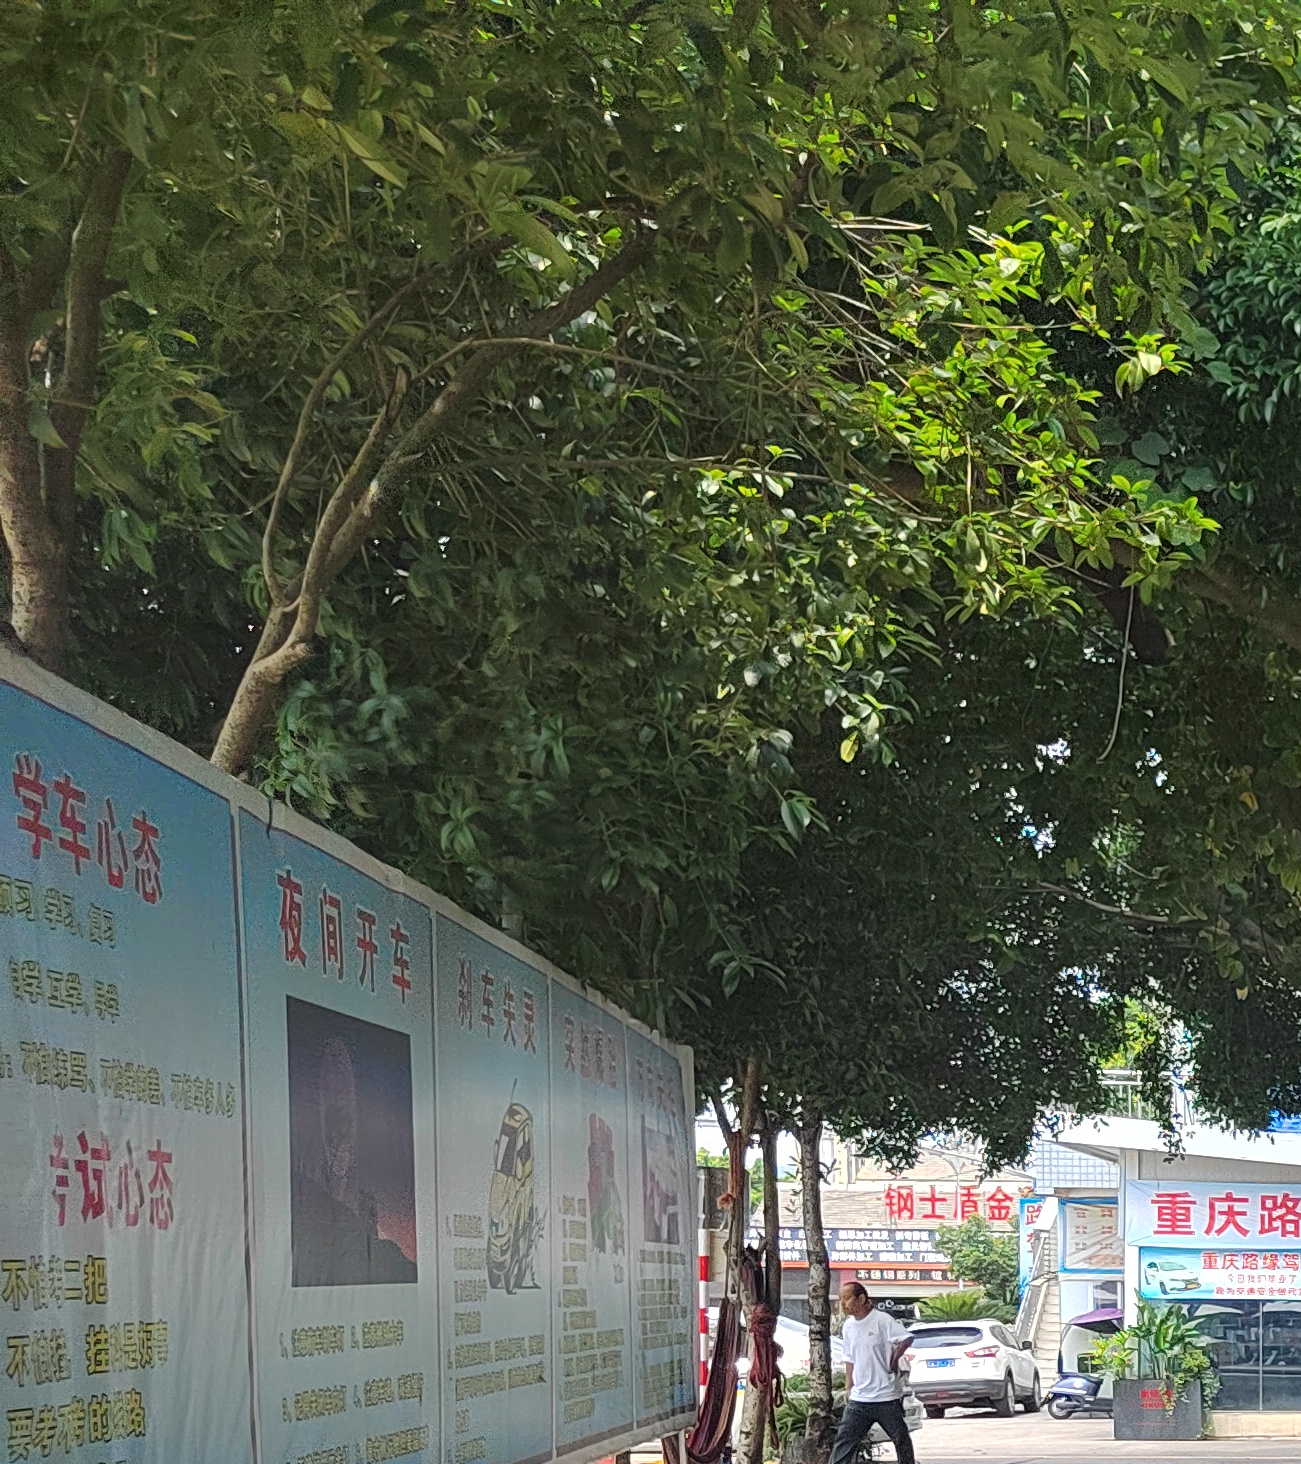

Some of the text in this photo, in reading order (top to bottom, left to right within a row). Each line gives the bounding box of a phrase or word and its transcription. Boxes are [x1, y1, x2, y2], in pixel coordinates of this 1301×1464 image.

[12, 754, 164, 905] 学车心态
[277, 868, 412, 1004] 夜间开车
[884, 1185, 1014, 1222] 钢士盾金
